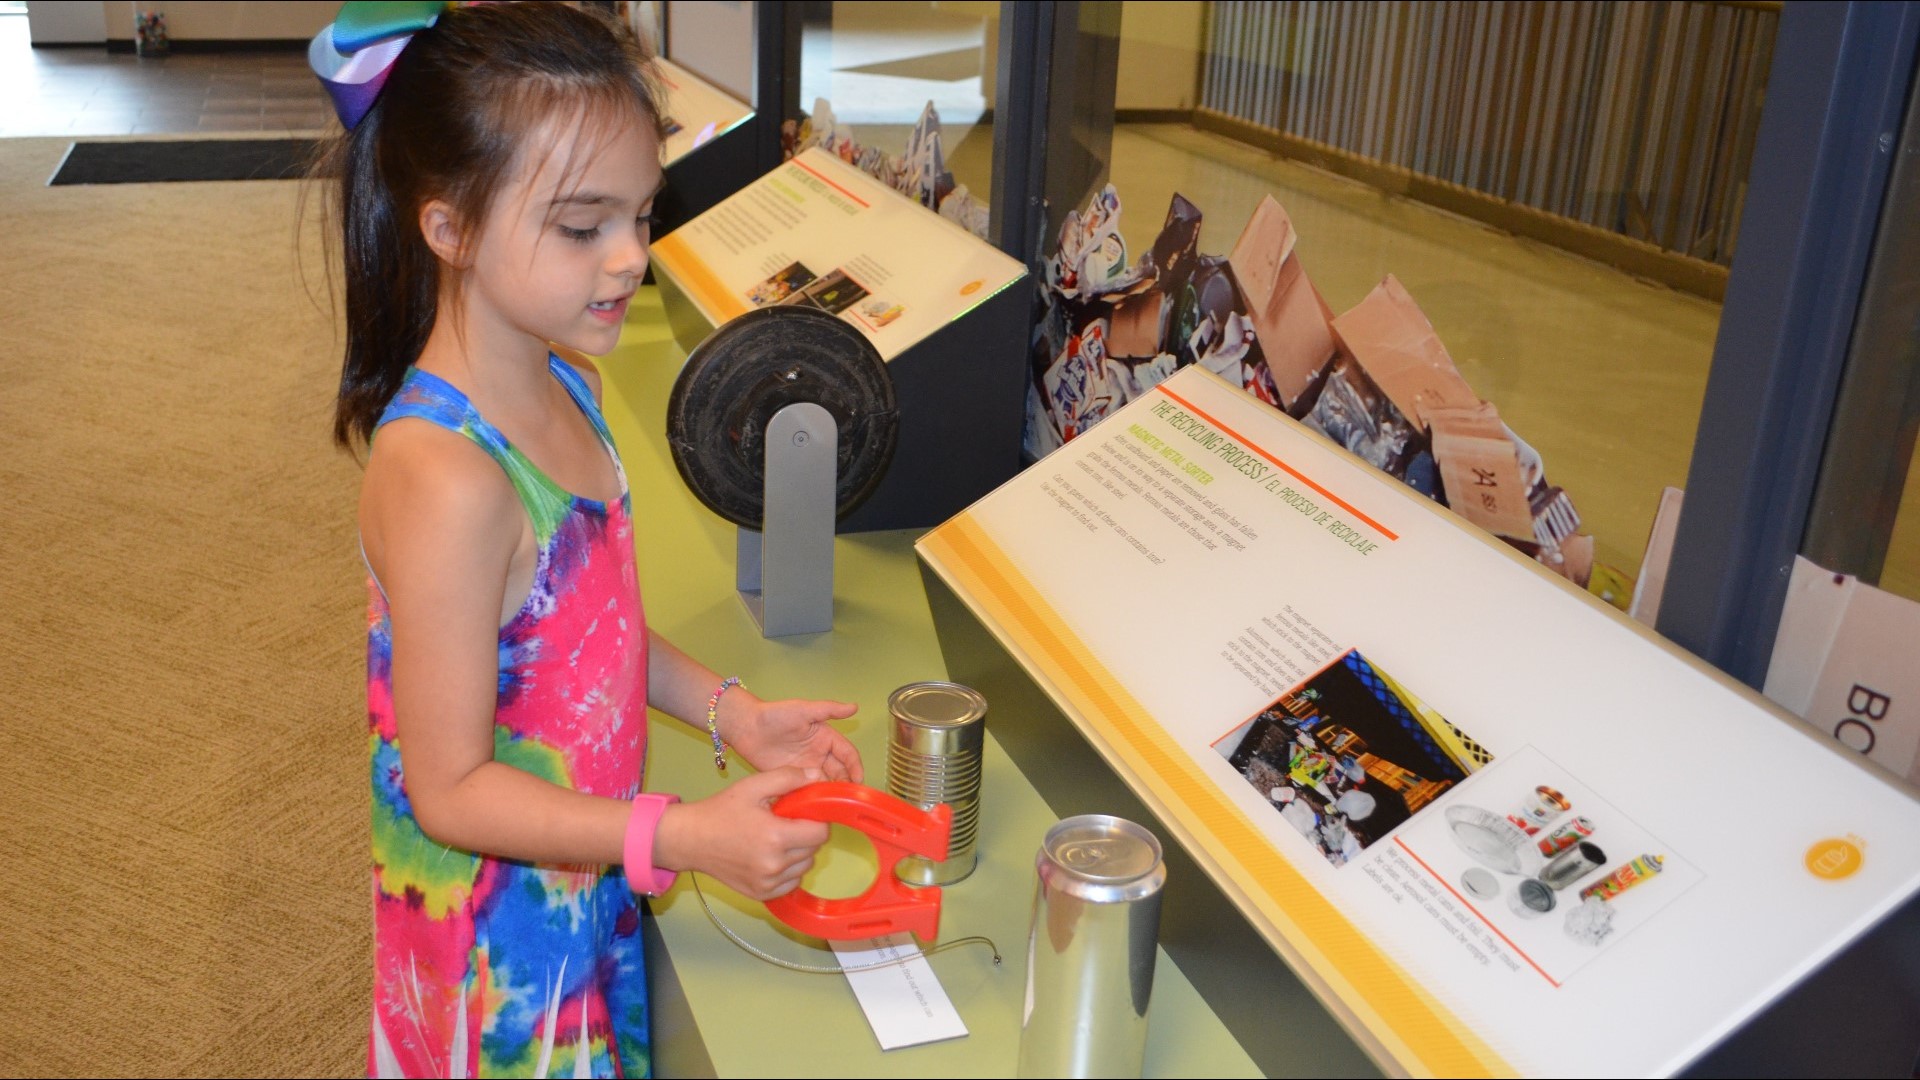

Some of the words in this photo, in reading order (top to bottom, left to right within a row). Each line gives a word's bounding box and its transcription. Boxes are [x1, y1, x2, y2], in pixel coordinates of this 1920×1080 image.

[1150, 400, 1176, 418] THE
[1167, 411, 1224, 449] RECYCLING
[1127, 424, 1164, 450] MAGNETIC
[1160, 446, 1186, 465] METAL
[1182, 462, 1214, 485] SORTER
[1214, 443, 1269, 479] PROCESS
[1258, 472, 1276, 484] /
[1265, 480, 1282, 491] EL
[1277, 487, 1319, 516] PROCESO
[1314, 512, 1332, 525] DE
[1327, 521, 1377, 555] RECICLAJE
[1147, 552, 1164, 565] iron?
